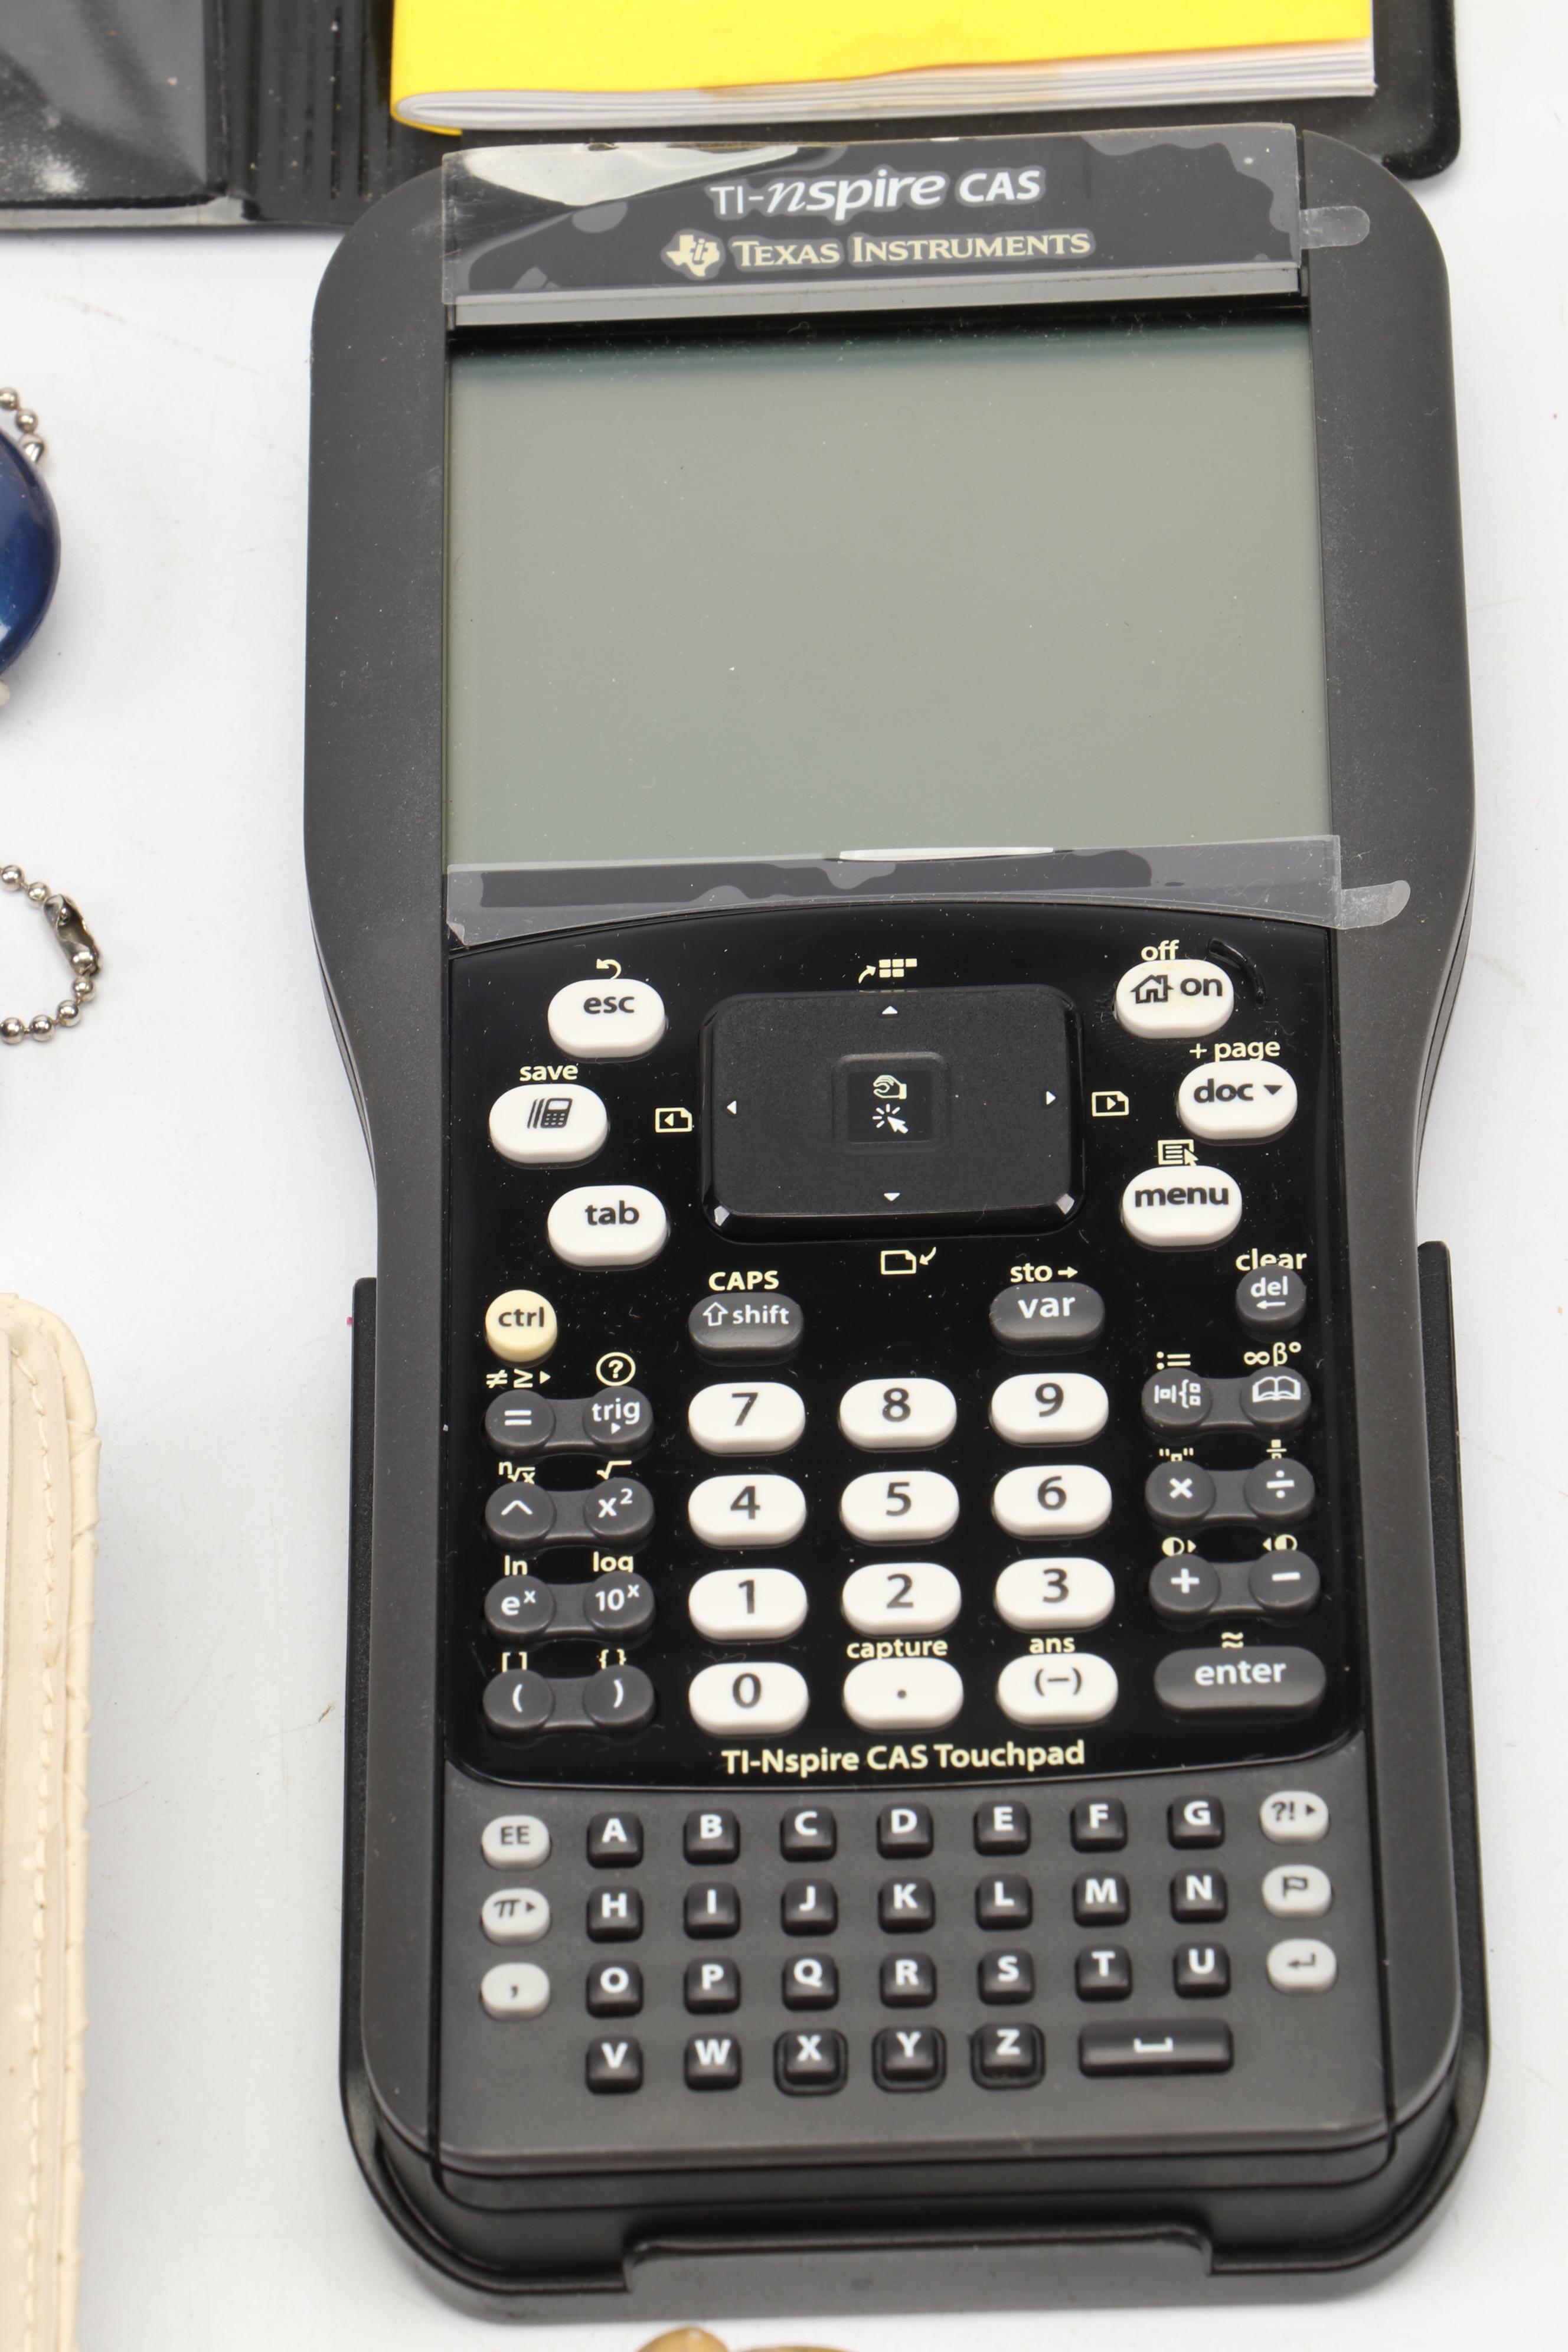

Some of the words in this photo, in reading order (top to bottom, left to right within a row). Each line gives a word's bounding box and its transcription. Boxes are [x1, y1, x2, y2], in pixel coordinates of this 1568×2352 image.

[959, 170, 1040, 203] CAS
[731, 240, 841, 267] TEXAS
[852, 233, 1091, 263] INSTRUMENTS
[1141, 940, 1180, 962] off
[1180, 978, 1223, 997] on
[583, 996, 635, 1015] esc
[1214, 1040, 1280, 1061] page
[519, 1064, 579, 1082] save
[1193, 1078, 1254, 1103] doc
[1135, 1187, 1229, 1208] menu
[584, 1200, 640, 1226] tab
[1236, 1248, 1307, 1271] clear
[708, 1270, 779, 1291] CAPS
[1010, 1263, 1053, 1283] sto
[1250, 1275, 1288, 1298] del
[498, 1306, 545, 1328] ctrl
[733, 1304, 789, 1325] shift
[1017, 1297, 1076, 1319] var
[592, 1398, 641, 1425] trig
[731, 1392, 759, 1426] 7
[882, 1387, 911, 1422] 8
[1035, 1383, 1064, 1417] 9
[730, 1485, 760, 1519] 4
[886, 1482, 912, 1516] 5
[1037, 1476, 1067, 1510] 6
[593, 1551, 633, 1573] log
[739, 1579, 754, 1613] 1
[887, 1573, 913, 1608] 2
[1043, 1568, 1069, 1603] 3
[847, 1639, 948, 1660] capture
[1029, 1636, 1075, 1654] ans
[1194, 1661, 1286, 1686] enter
[732, 1672, 762, 1708] 0
[721, 1747, 860, 1778] TI-Nspire
[867, 1744, 928, 1770] CAS
[933, 1739, 1084, 1772] Touchpad
[700, 1814, 723, 1840] B
[795, 1811, 818, 1837] C
[891, 1808, 917, 1834] D
[994, 1806, 1014, 1832] E
[1089, 1804, 1108, 1830] F
[1184, 1801, 1211, 1827] G
[500, 1825, 529, 1845] EE
[602, 1818, 628, 1844] A
[799, 1886, 816, 1912] J
[893, 1883, 918, 1910] K
[994, 1881, 1015, 1908] L
[1085, 1879, 1118, 1905] M
[1186, 1875, 1213, 1902] N
[602, 1893, 627, 1919] H
[707, 1889, 717, 1915] I
[793, 1959, 822, 1988] Q
[896, 1959, 919, 1987] R
[998, 1955, 1019, 1984] S
[1092, 1951, 1115, 1978] T
[1189, 1948, 1214, 1975] U
[600, 1967, 629, 1994] O
[701, 1964, 724, 1991] P
[695, 2039, 731, 2067] W
[797, 2035, 822, 2062] X
[897, 2031, 921, 2059] Y
[996, 2029, 1021, 2056] Z
[602, 2043, 628, 2070] V
